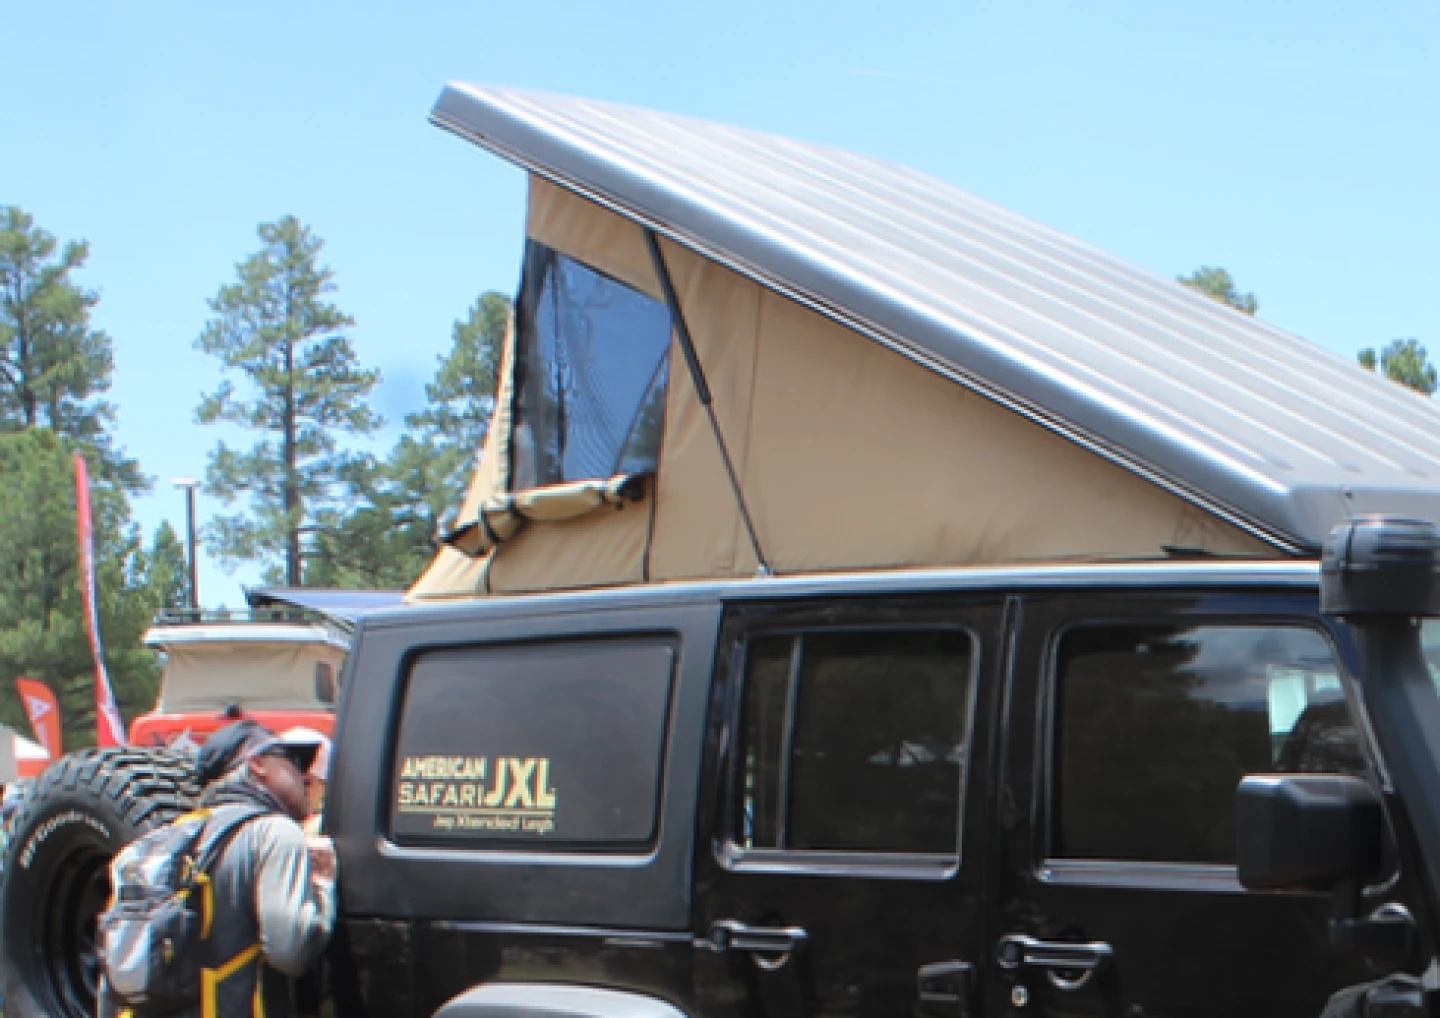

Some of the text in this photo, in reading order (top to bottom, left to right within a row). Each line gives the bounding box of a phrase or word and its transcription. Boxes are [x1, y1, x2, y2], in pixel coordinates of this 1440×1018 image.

[398, 782, 485, 807] SAFARI
[401, 756, 557, 808] AMERICAN JXL
